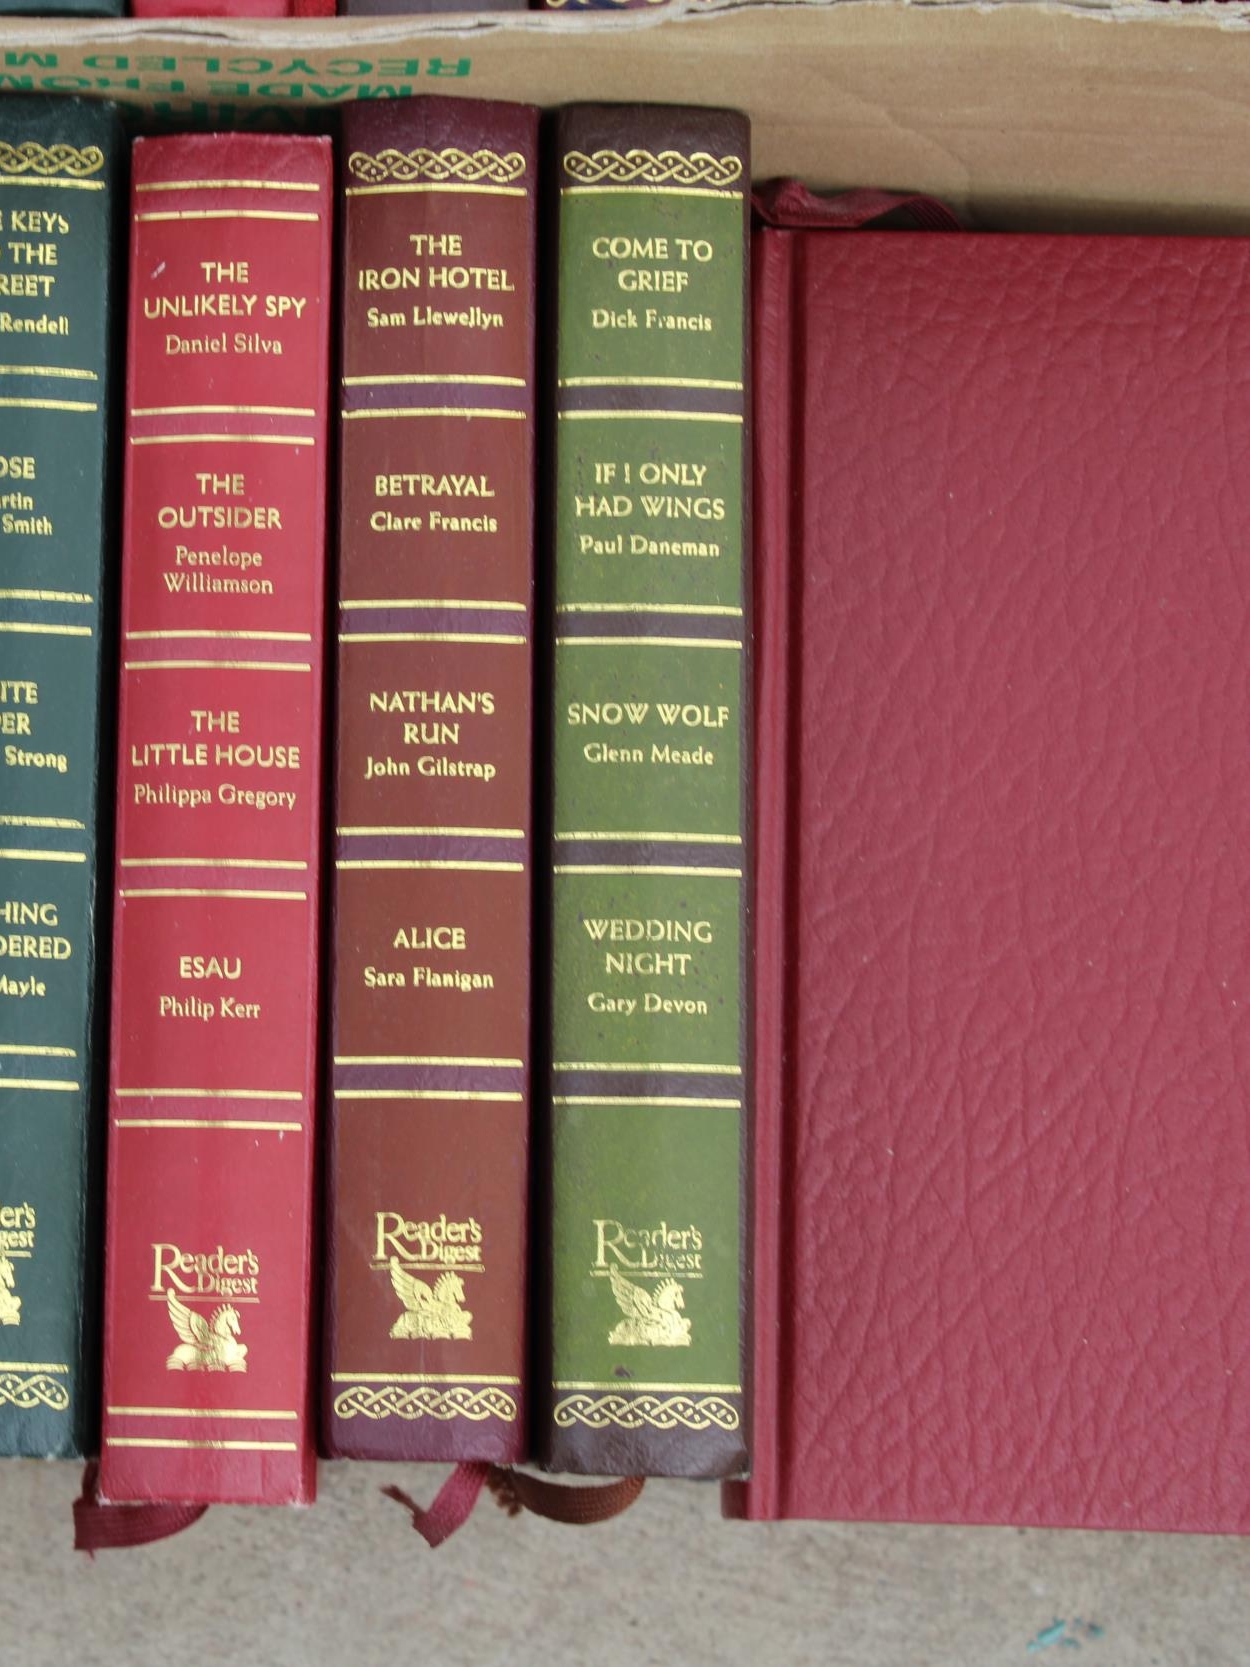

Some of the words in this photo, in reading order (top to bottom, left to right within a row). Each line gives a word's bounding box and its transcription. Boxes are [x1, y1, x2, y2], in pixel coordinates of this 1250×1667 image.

[82, 54, 473, 78] RECYCLED
[206, 79, 414, 99] MADE
[12, 211, 69, 234] KEYS
[8, 242, 57, 265] THE
[410, 234, 462, 256] THE
[593, 237, 668, 259] COME
[675, 239, 713, 262] TO
[201, 262, 248, 283] THE
[359, 267, 420, 290] IRON
[429, 267, 514, 291] HOTEL
[618, 269, 688, 292] GRIEF
[145, 294, 257, 318] UNLIKELY
[266, 295, 306, 318] SPY
[0, 312, 68, 335] Rendell
[367, 308, 406, 327] Sam
[414, 306, 503, 330] Llewellyn
[592, 309, 638, 328] Dick
[646, 309, 712, 331] Francis
[166, 332, 227, 354] Daniel
[234, 333, 282, 355] Silva
[196, 473, 244, 495] THE
[376, 474, 495, 497] BETRAYAL
[595, 463, 616, 484] IF
[625, 463, 630, 483] I
[640, 463, 707, 486] ONLY
[158, 506, 282, 529] OUTSIDER
[575, 496, 632, 516] HAD
[641, 496, 725, 520] WINGS
[2, 514, 52, 535] Smith
[370, 511, 422, 531] Clare
[430, 511, 497, 532] Francis
[580, 535, 622, 554] Paul
[630, 535, 719, 556] Daneman
[176, 545, 262, 570] Penelope
[164, 572, 273, 594] Williamson
[370, 691, 494, 714] NATHAN'S
[190, 710, 239, 733] THE
[568, 703, 649, 724] SNOW
[656, 704, 729, 727] WOLF
[404, 723, 459, 744] RUN
[5, 749, 67, 772] Strong
[132, 743, 207, 766] LITTLE
[216, 745, 300, 768] HOUSE
[584, 743, 643, 762] Glenn
[651, 744, 713, 765] Meade
[365, 757, 410, 779] John
[418, 756, 496, 782] Gilstrap
[135, 783, 211, 808] Philippa
[218, 784, 296, 810] Gregory
[393, 927, 466, 949] ALICE
[583, 919, 712, 943] WEDDING
[180, 956, 241, 979] ESAU
[606, 953, 691, 975] NIGHT
[365, 967, 405, 988] Sara
[414, 967, 494, 992] Flanigan
[160, 996, 214, 1021] Philip
[221, 997, 260, 1018] Kerr
[588, 992, 637, 1016] Gary
[645, 993, 707, 1014] Devon
[374, 1212, 482, 1261] Reader's
[592, 1219, 703, 1268] Reader's
[419, 1239, 481, 1264] Digest
[150, 1243, 259, 1294] Reader's
[196, 1272, 258, 1295] Digest
